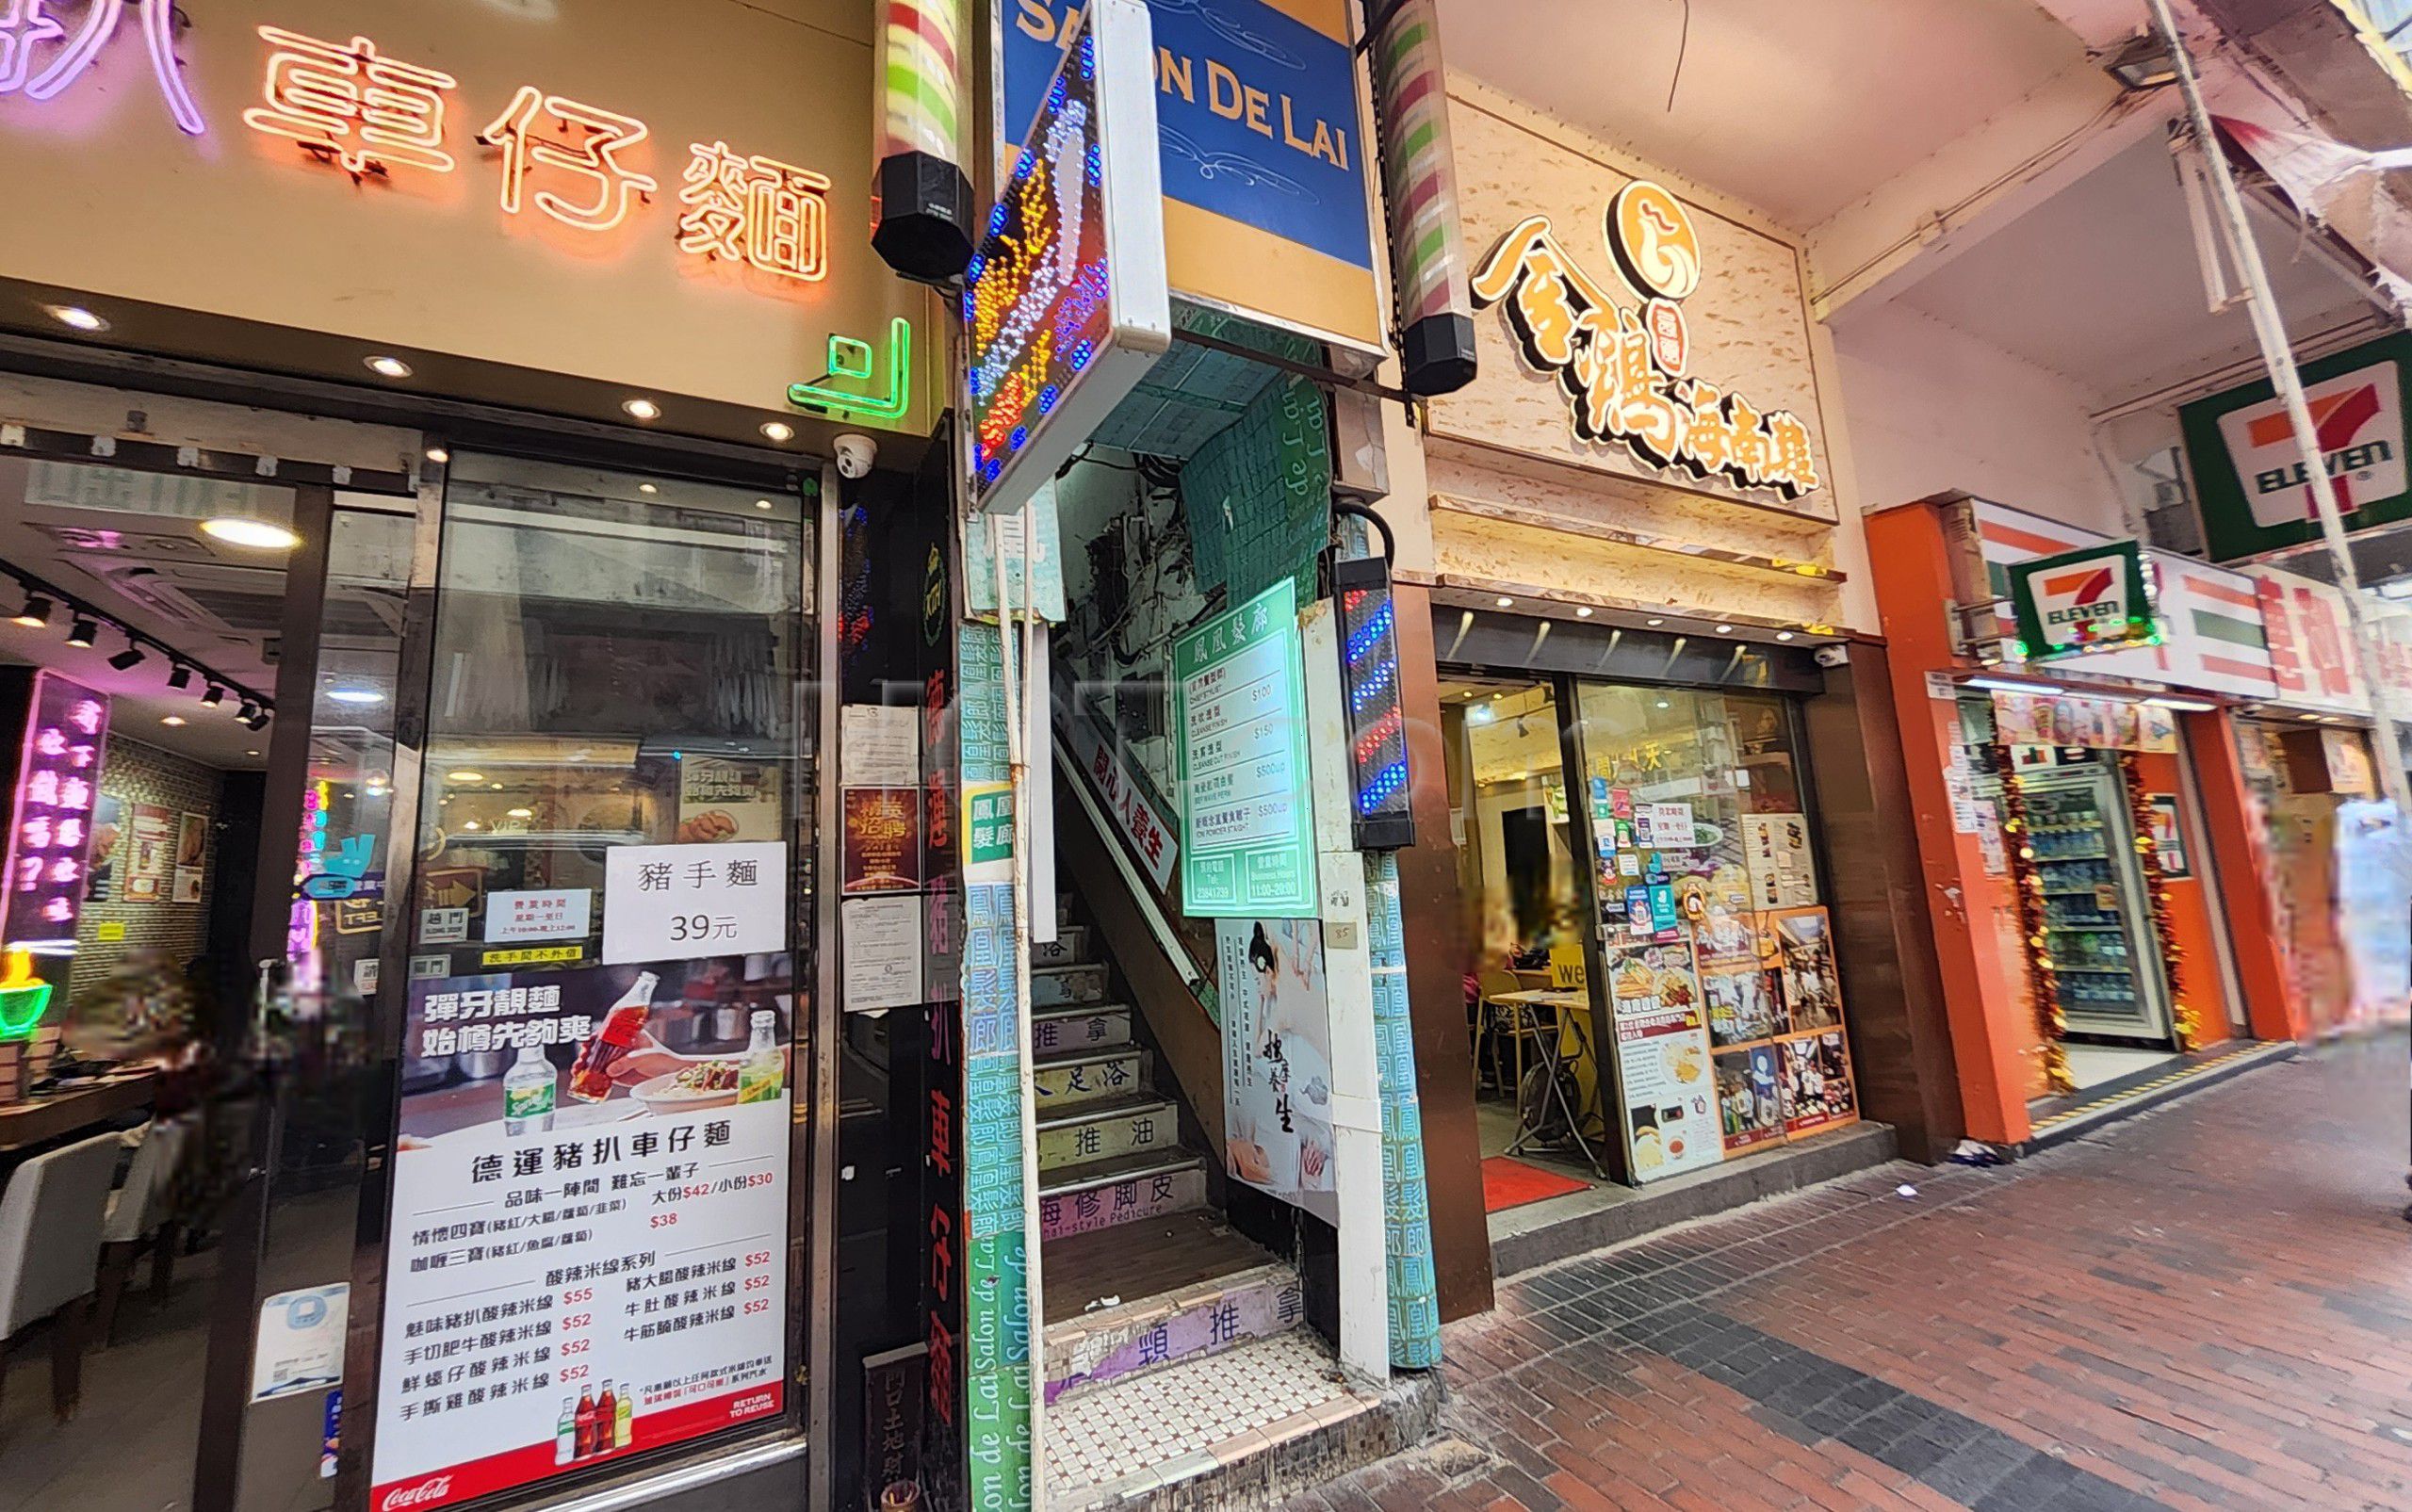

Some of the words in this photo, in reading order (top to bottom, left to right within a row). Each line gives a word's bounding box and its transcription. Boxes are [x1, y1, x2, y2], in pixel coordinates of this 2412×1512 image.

[638, 858, 759, 893] 豬手麵
[670, 914, 739, 941] 39元
[424, 984, 562, 1024] 彈牙靚麵
[471, 1119, 733, 1185] 德運豬扒車仔麵
[1074, 1116, 1154, 1157] 推油
[649, 1212, 678, 1230] $38
[545, 1250, 656, 1288] 酸辣米線系列
[744, 1250, 771, 1268] $52
[563, 1287, 594, 1306] $55
[625, 1280, 736, 1318] 牛肚酸辣米線
[743, 1275, 770, 1292] $52
[743, 1298, 770, 1316] $52
[403, 1319, 553, 1366] 手切肥牛酸辣米線
[562, 1313, 593, 1331] $52
[560, 1339, 591, 1357] $52
[559, 1364, 590, 1383] $52
